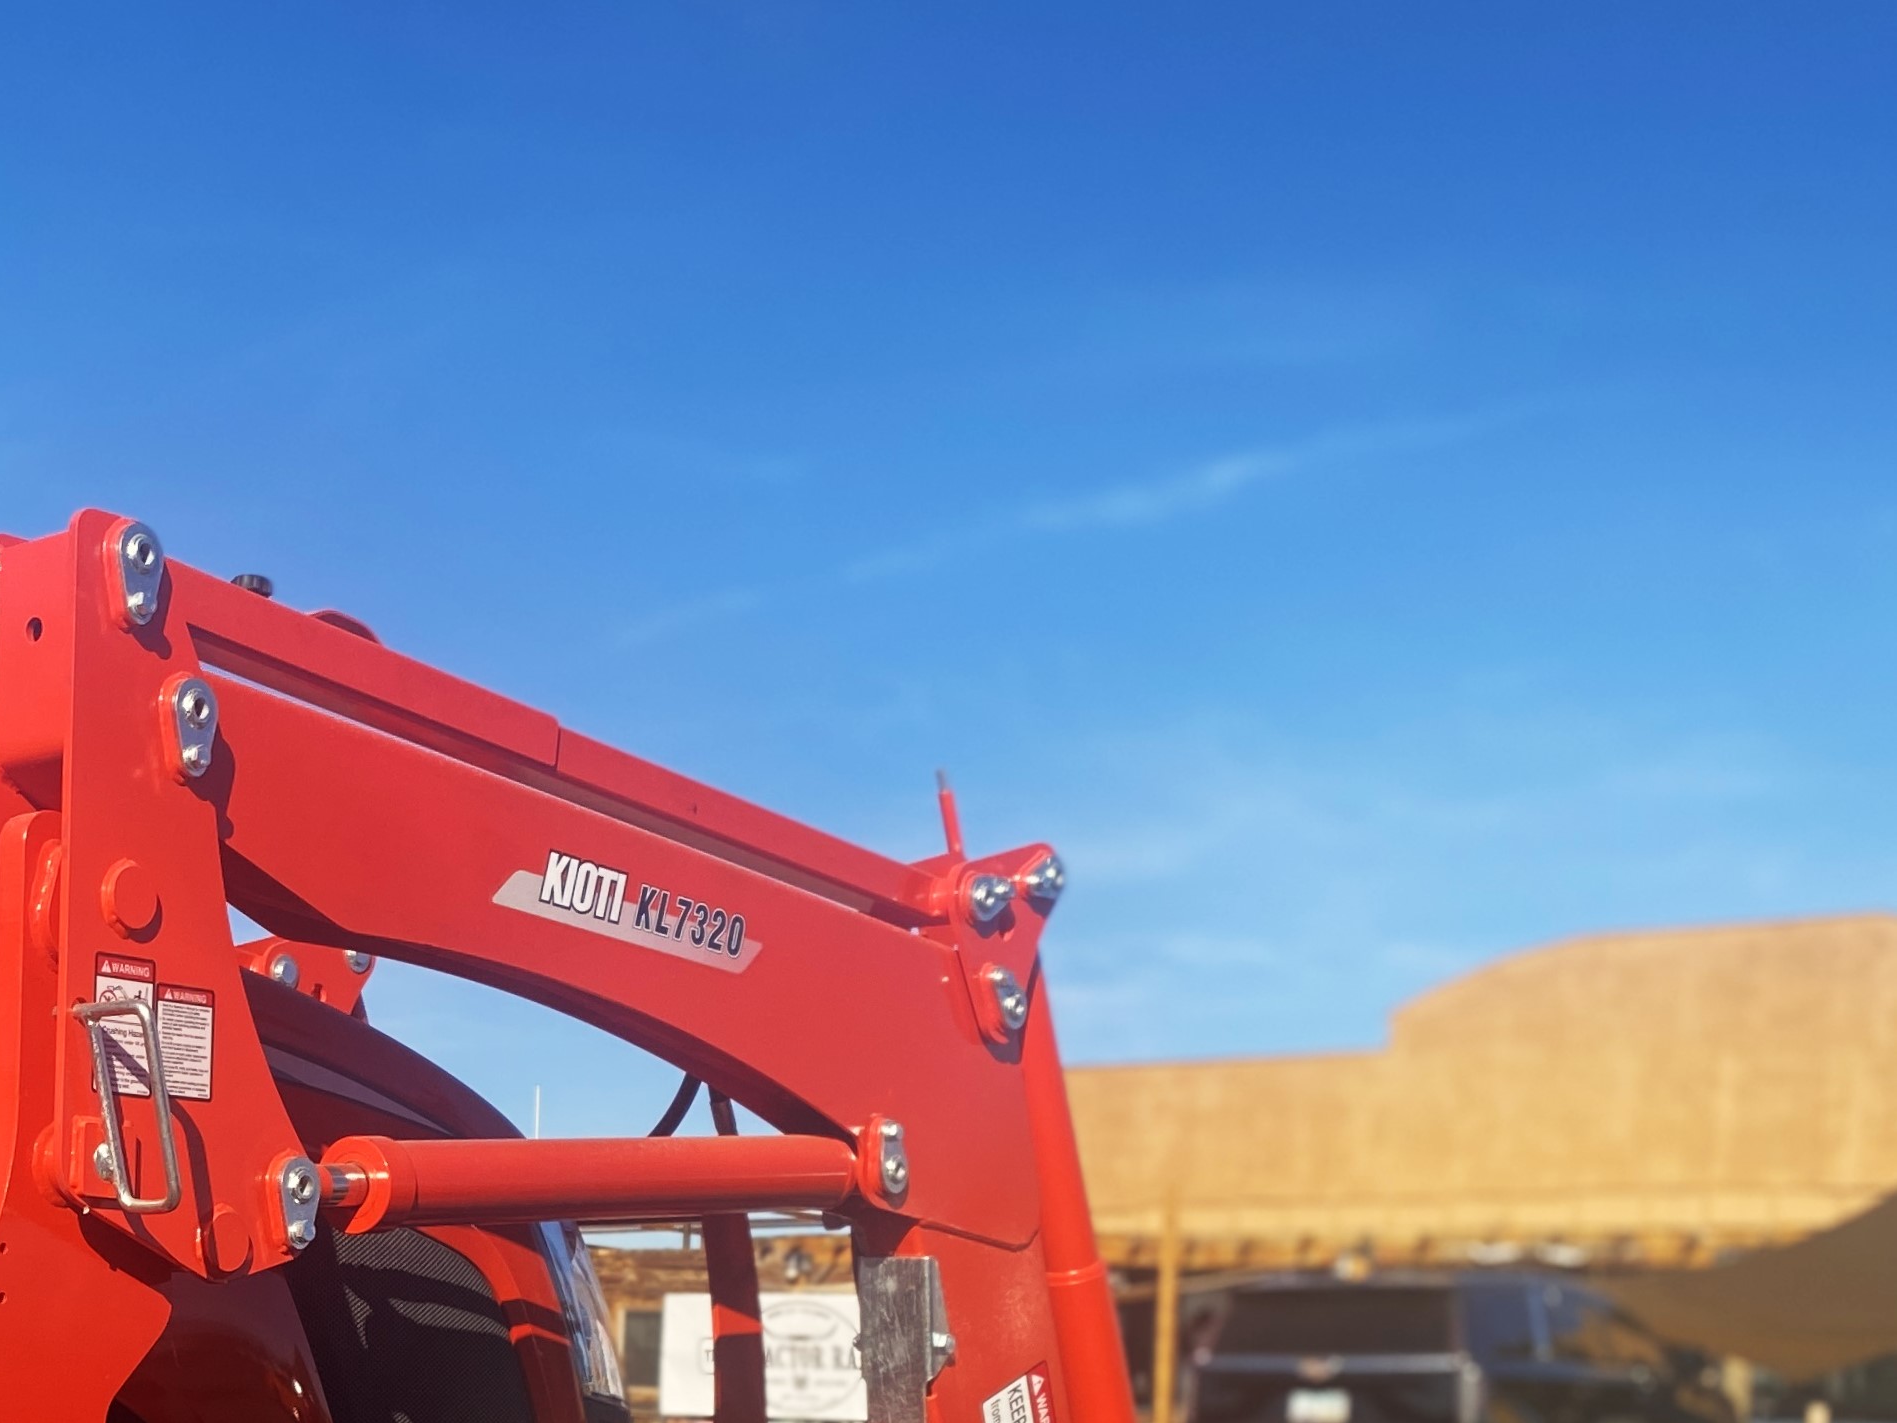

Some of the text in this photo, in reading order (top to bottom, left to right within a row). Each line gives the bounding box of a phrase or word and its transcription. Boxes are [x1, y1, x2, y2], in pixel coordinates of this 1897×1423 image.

[540, 851, 746, 959] KIOTI KL7320
[111, 962, 150, 978] WARNING
[173, 991, 207, 1004] WARNING
